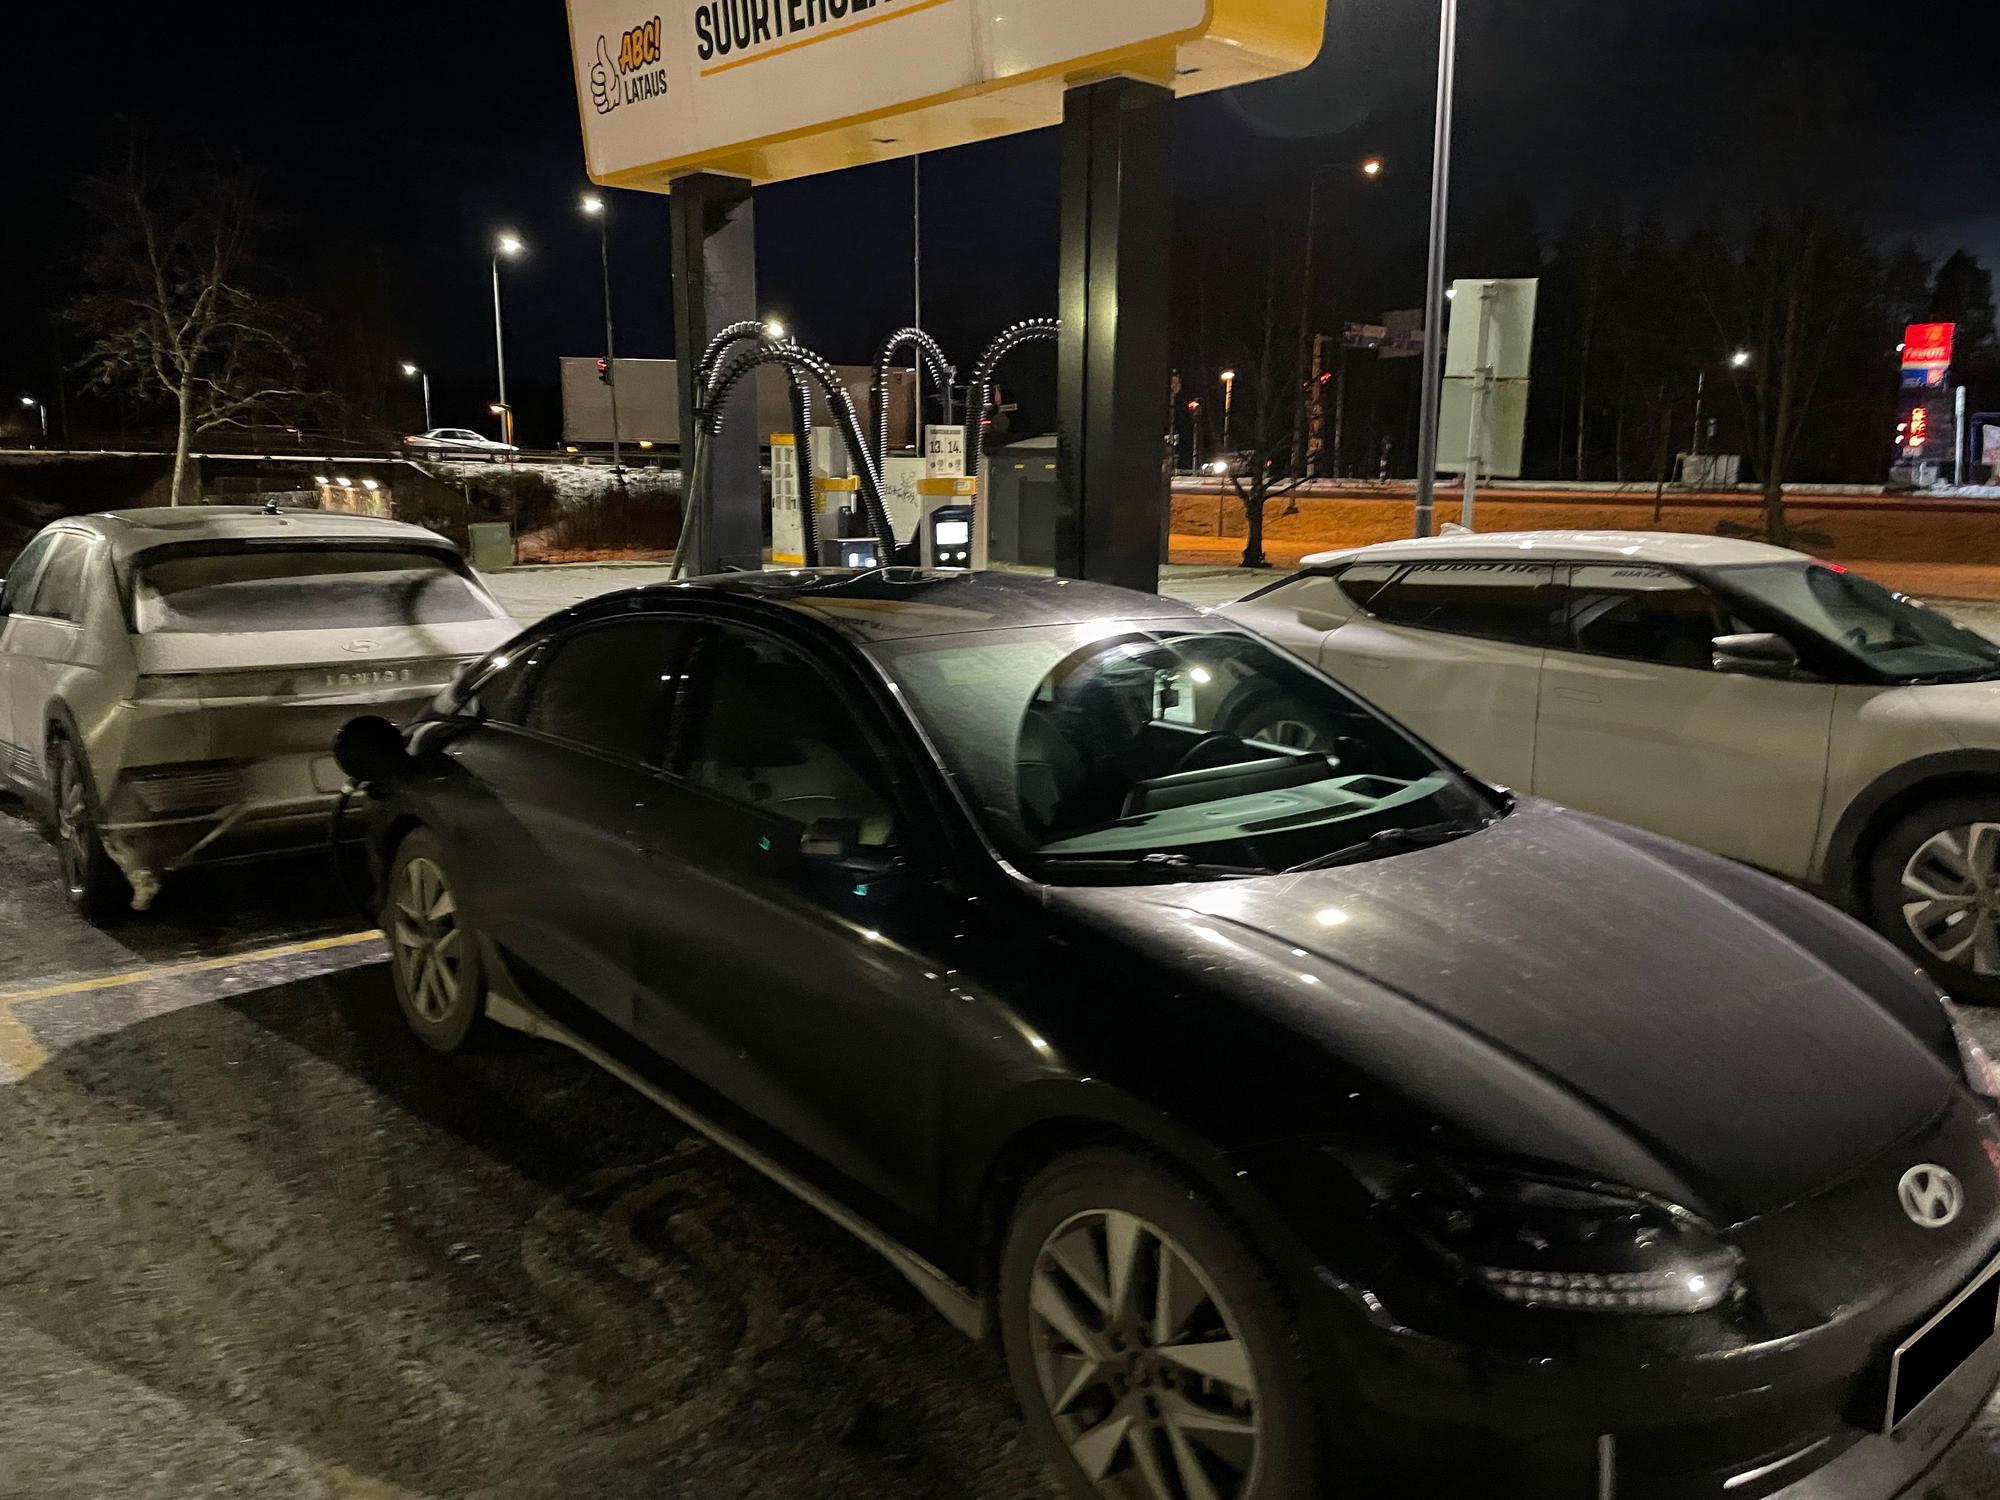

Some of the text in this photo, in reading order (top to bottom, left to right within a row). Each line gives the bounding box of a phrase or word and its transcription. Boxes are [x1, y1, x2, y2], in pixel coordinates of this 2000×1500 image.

[618, 15, 661, 75] ABC!
[695, 0, 894, 60] SUURTEH
[624, 69, 667, 104] LATAUS
